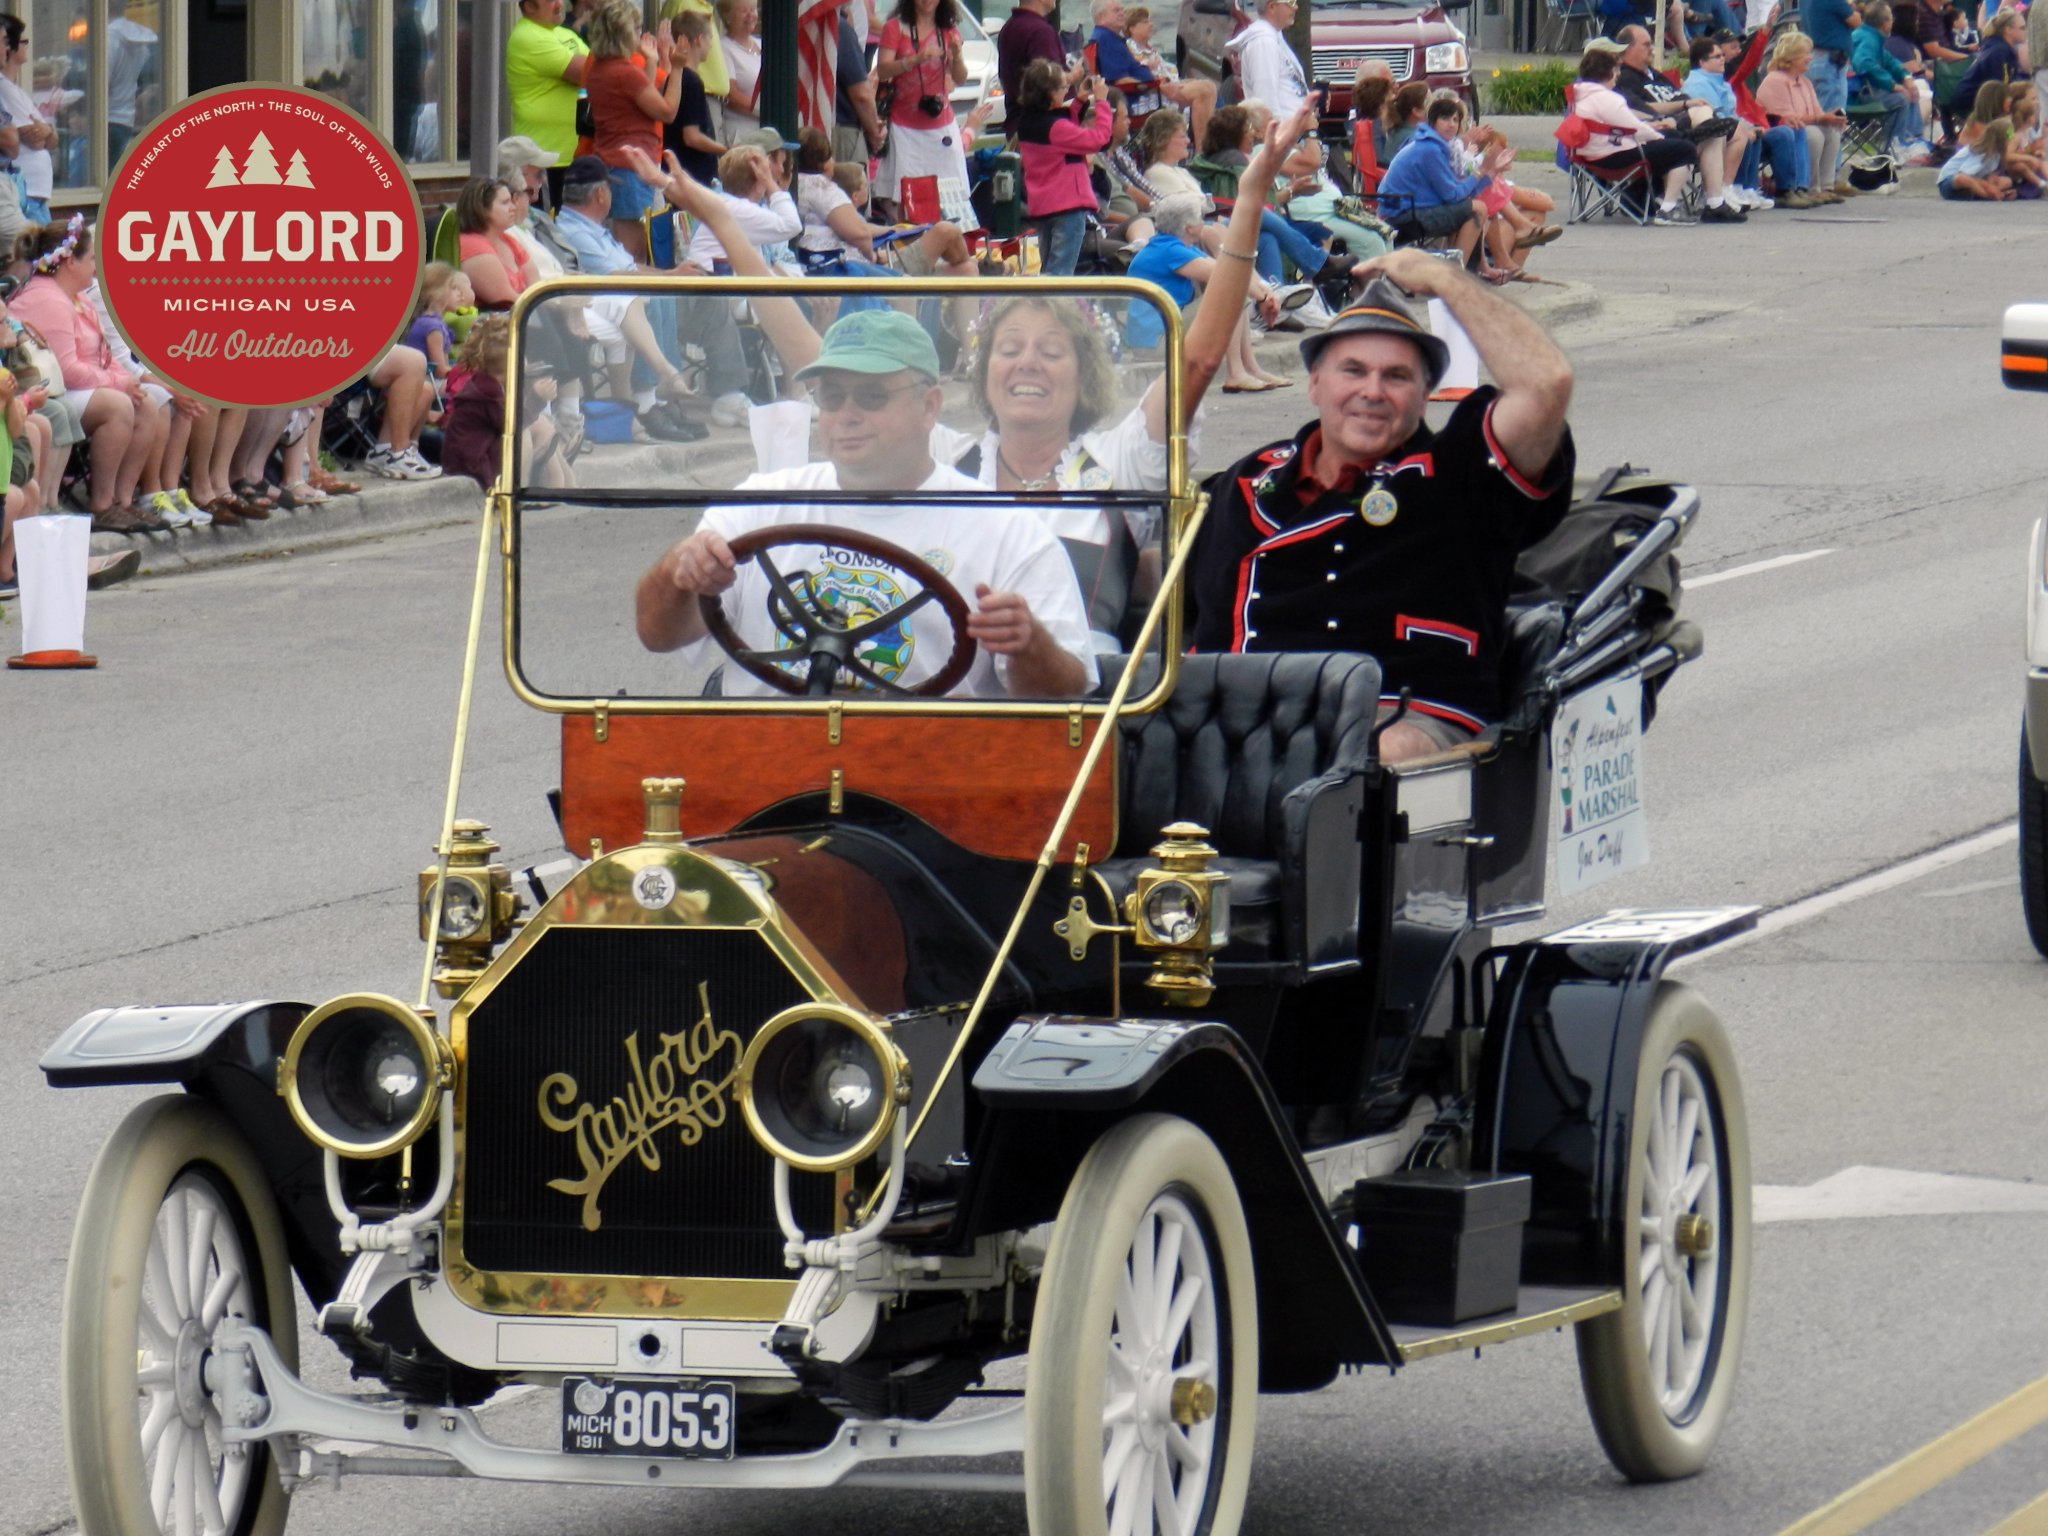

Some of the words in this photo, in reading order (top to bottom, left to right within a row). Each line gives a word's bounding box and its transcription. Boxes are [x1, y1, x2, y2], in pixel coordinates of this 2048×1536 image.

[1584, 749, 1636, 792] PARADE
[1577, 777, 1639, 824] MARSHAL
[538, 979, 744, 1232] Gaylord
[567, 1414, 613, 1434] MICH
[613, 1390, 730, 1450] 8053
[576, 1434, 602, 1448] 1911
